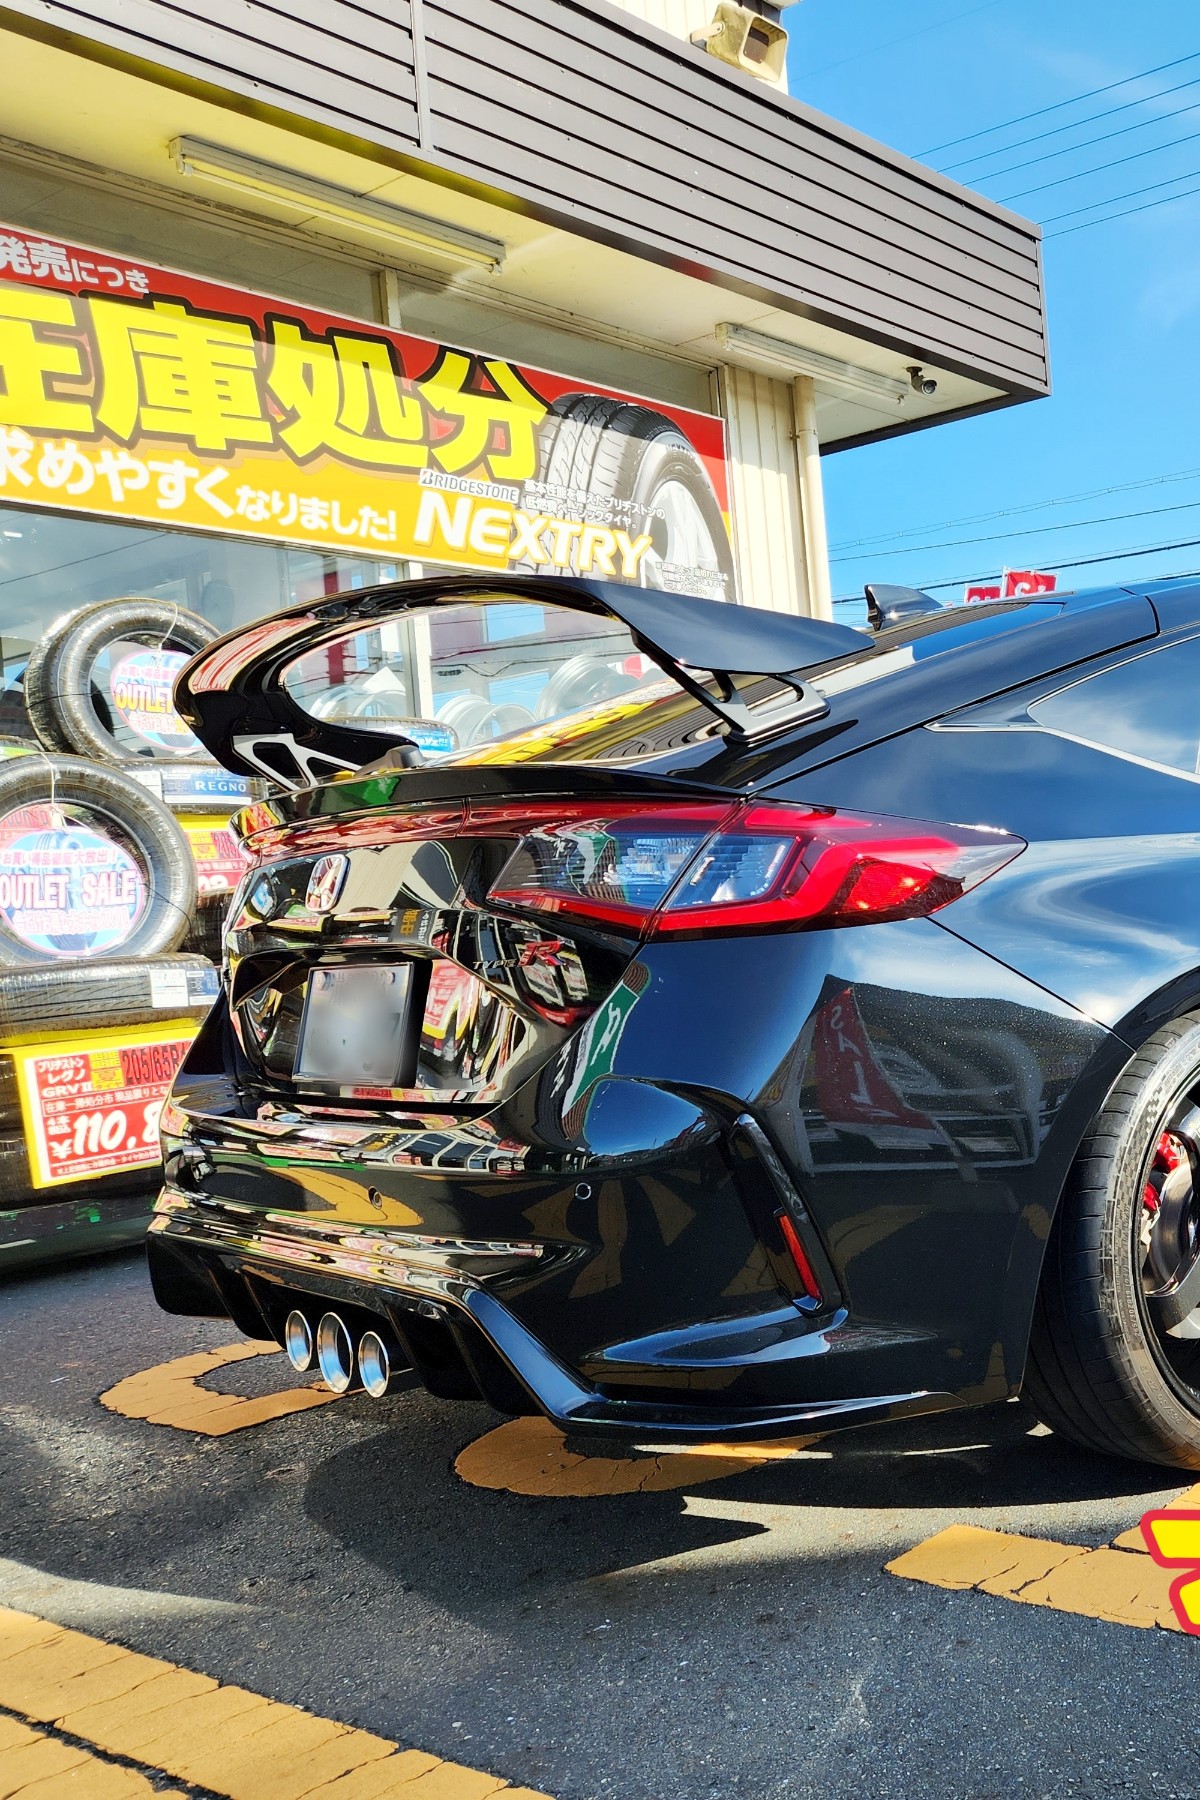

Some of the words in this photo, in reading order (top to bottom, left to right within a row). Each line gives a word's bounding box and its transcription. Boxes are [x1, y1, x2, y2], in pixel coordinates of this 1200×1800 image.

[0, 234, 149, 294] 発売につき
[420, 470, 518, 503] BRIDGESTONE
[414, 490, 652, 578] NEXTRY
[115, 682, 174, 714] OUTLET
[195, 780, 247, 793] REGNO
[0, 873, 70, 910] OUTLET
[82, 869, 138, 907] SALE
[472, 958, 518, 970] TYPE
[517, 940, 566, 967] R
[48, 1068, 86, 1084] レグノ
